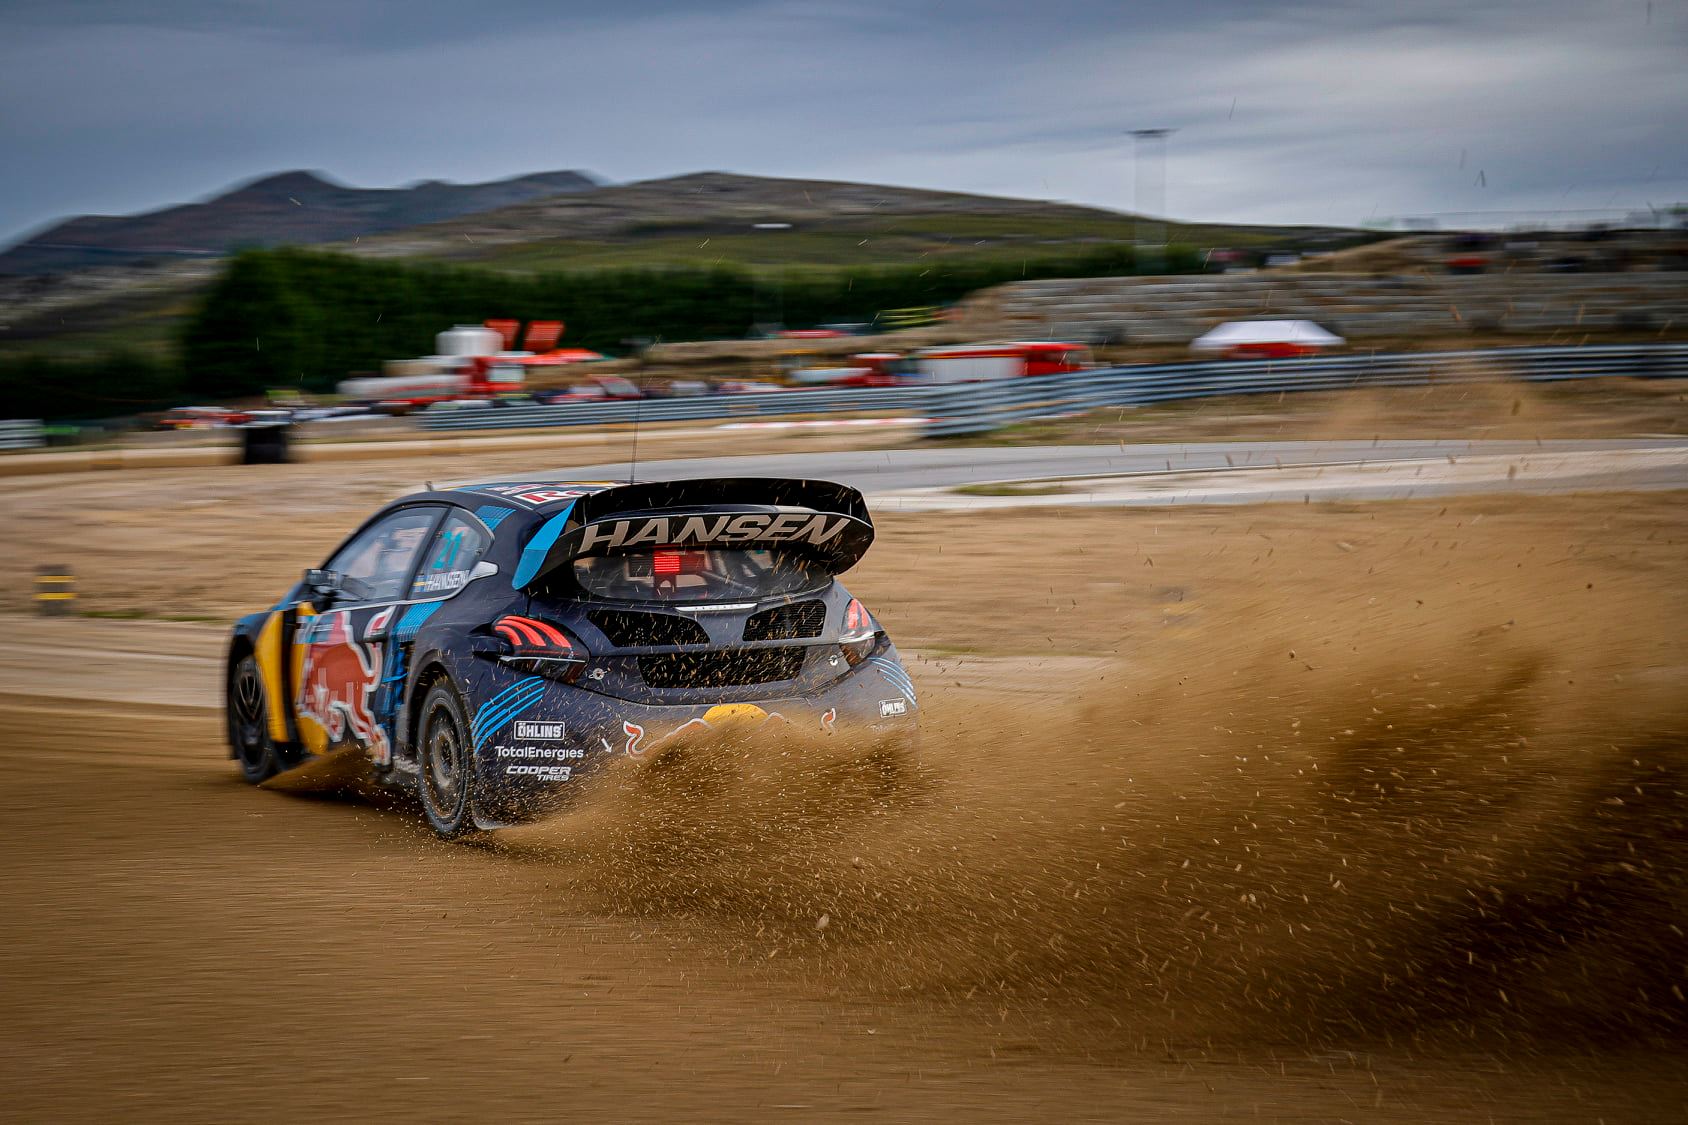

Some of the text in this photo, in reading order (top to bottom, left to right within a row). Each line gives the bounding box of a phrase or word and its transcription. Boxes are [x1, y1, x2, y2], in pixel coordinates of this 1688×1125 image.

[577, 514, 851, 553] HANSEN
[432, 530, 464, 568] 21
[517, 722, 562, 738] ÖHLINS
[495, 746, 584, 760] TotalEnergies
[506, 765, 572, 775] COOPER
